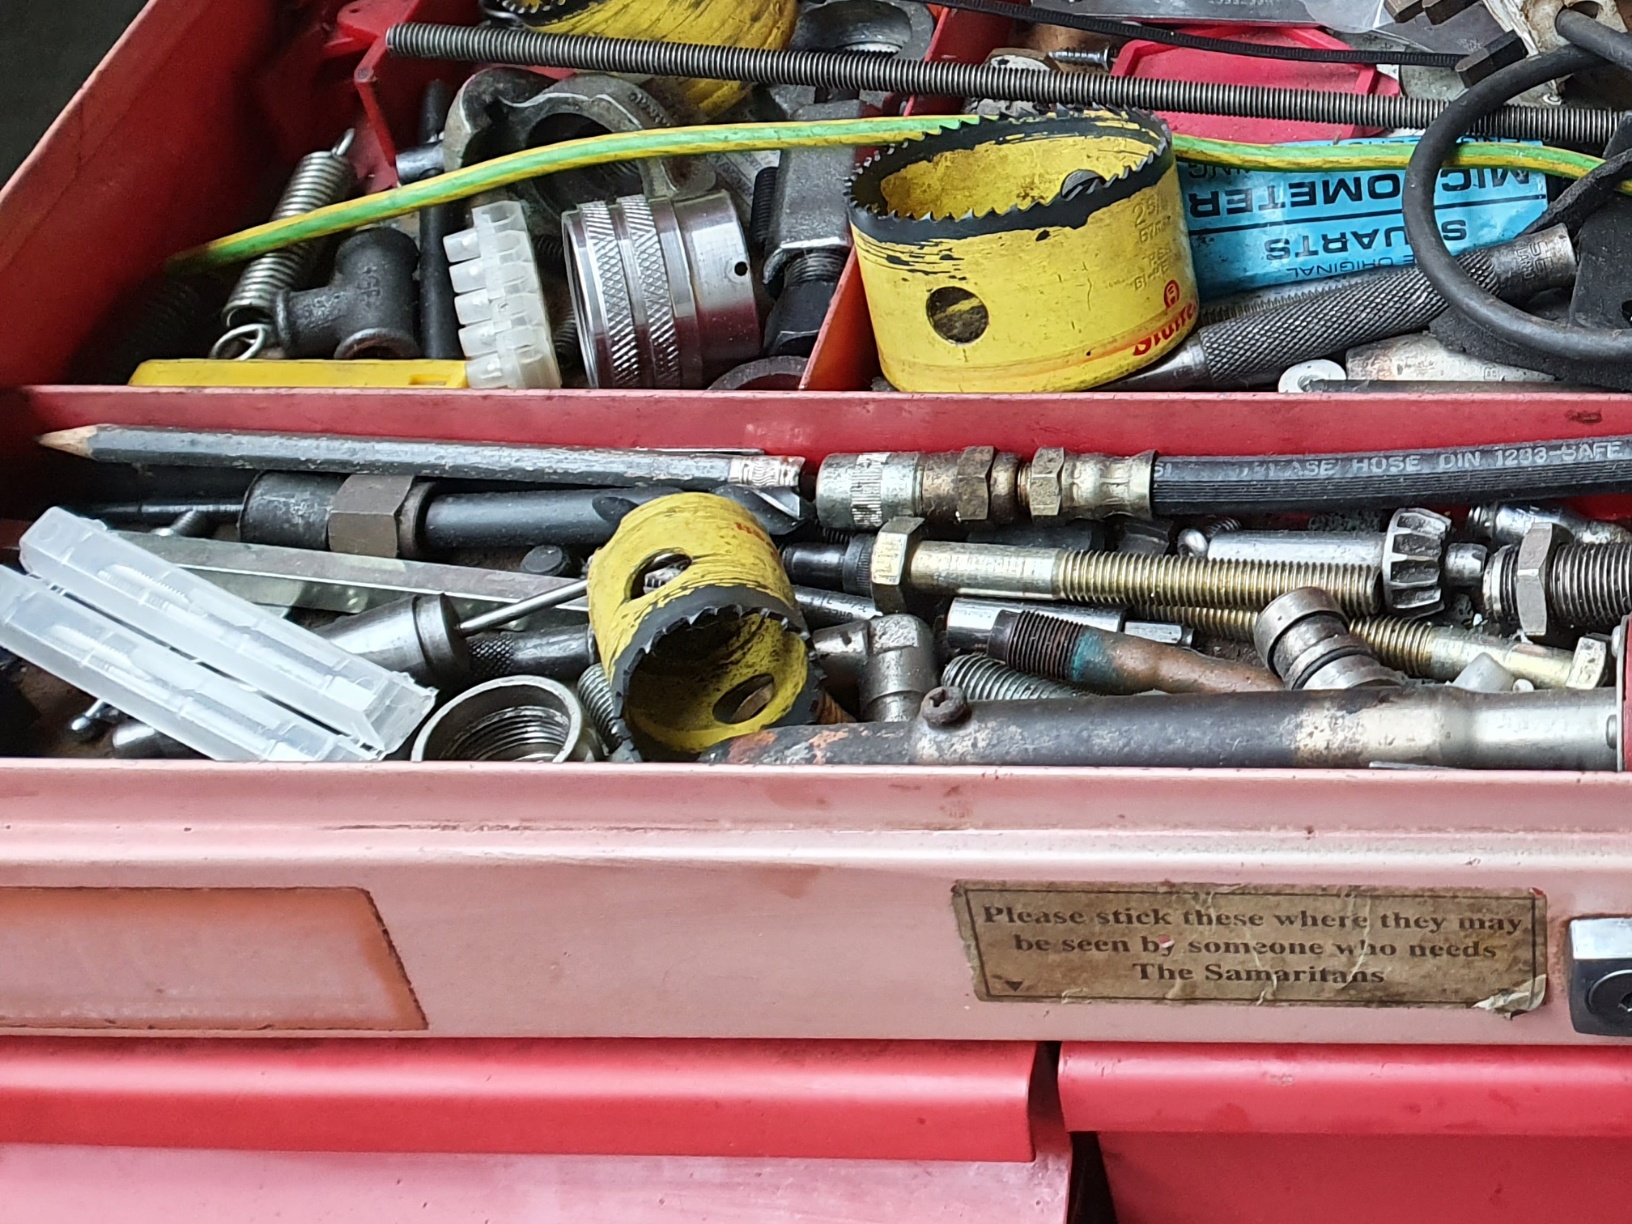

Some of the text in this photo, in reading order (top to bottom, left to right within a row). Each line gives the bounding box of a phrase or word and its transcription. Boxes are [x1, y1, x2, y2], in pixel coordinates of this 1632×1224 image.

[1188, 167, 1530, 218] MICOMETER
[1264, 220, 1467, 261] SUARTS
[1351, 455, 1422, 473] HOSE
[1439, 450, 1481, 469] DIN
[983, 905, 1523, 935] Please stick these where they may
[1014, 934, 1498, 959] be seen by someone who needs
[1133, 963, 1386, 984] The Samaritans
